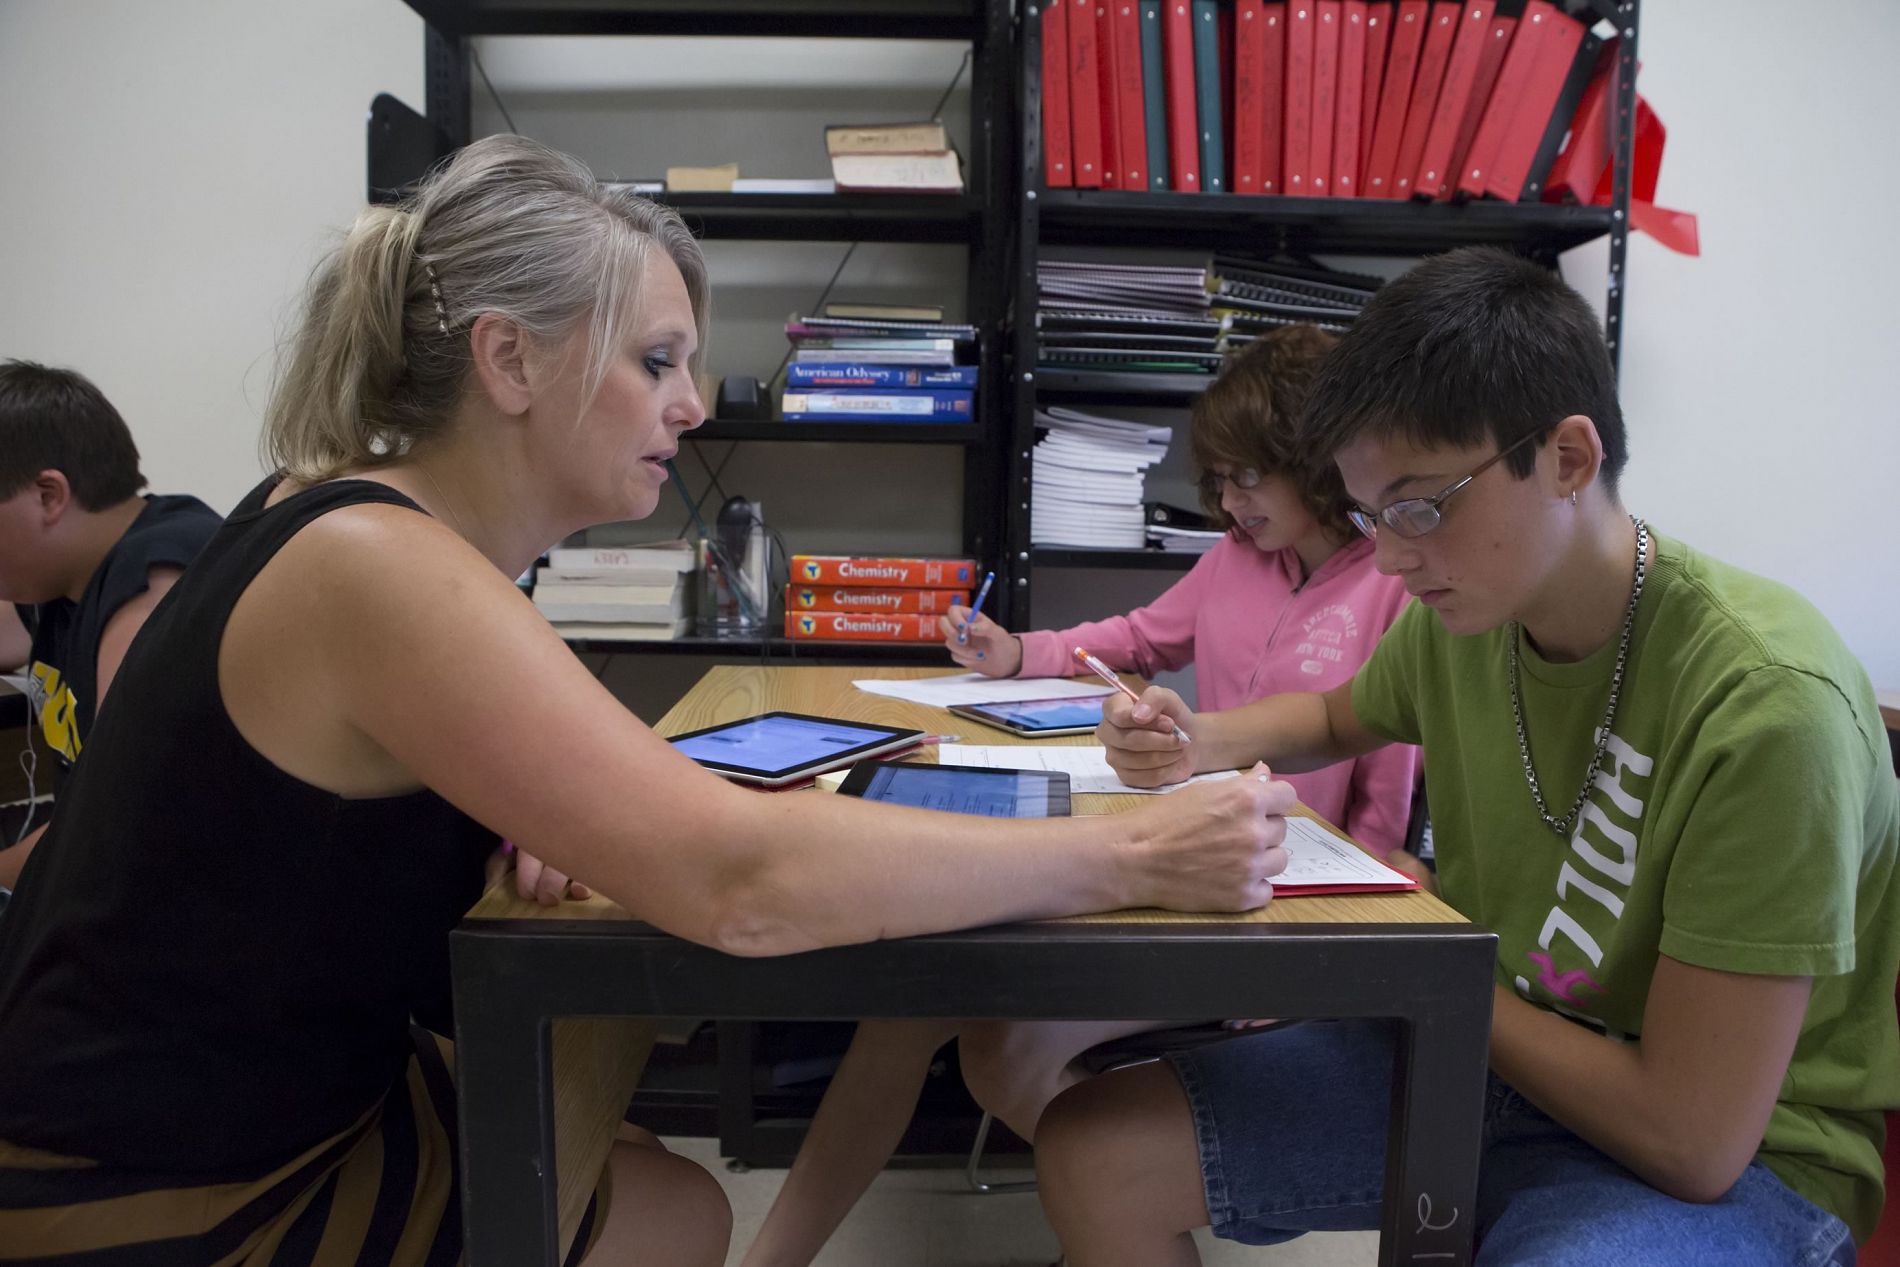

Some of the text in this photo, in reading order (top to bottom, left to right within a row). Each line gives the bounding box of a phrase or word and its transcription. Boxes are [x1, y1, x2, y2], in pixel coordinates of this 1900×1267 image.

[794, 366, 844, 378] American
[838, 562, 909, 582] Chemistry
[833, 590, 902, 608] Chemistry
[833, 616, 902, 636] Chemistry
[1516, 726, 1654, 1000] HOLL
